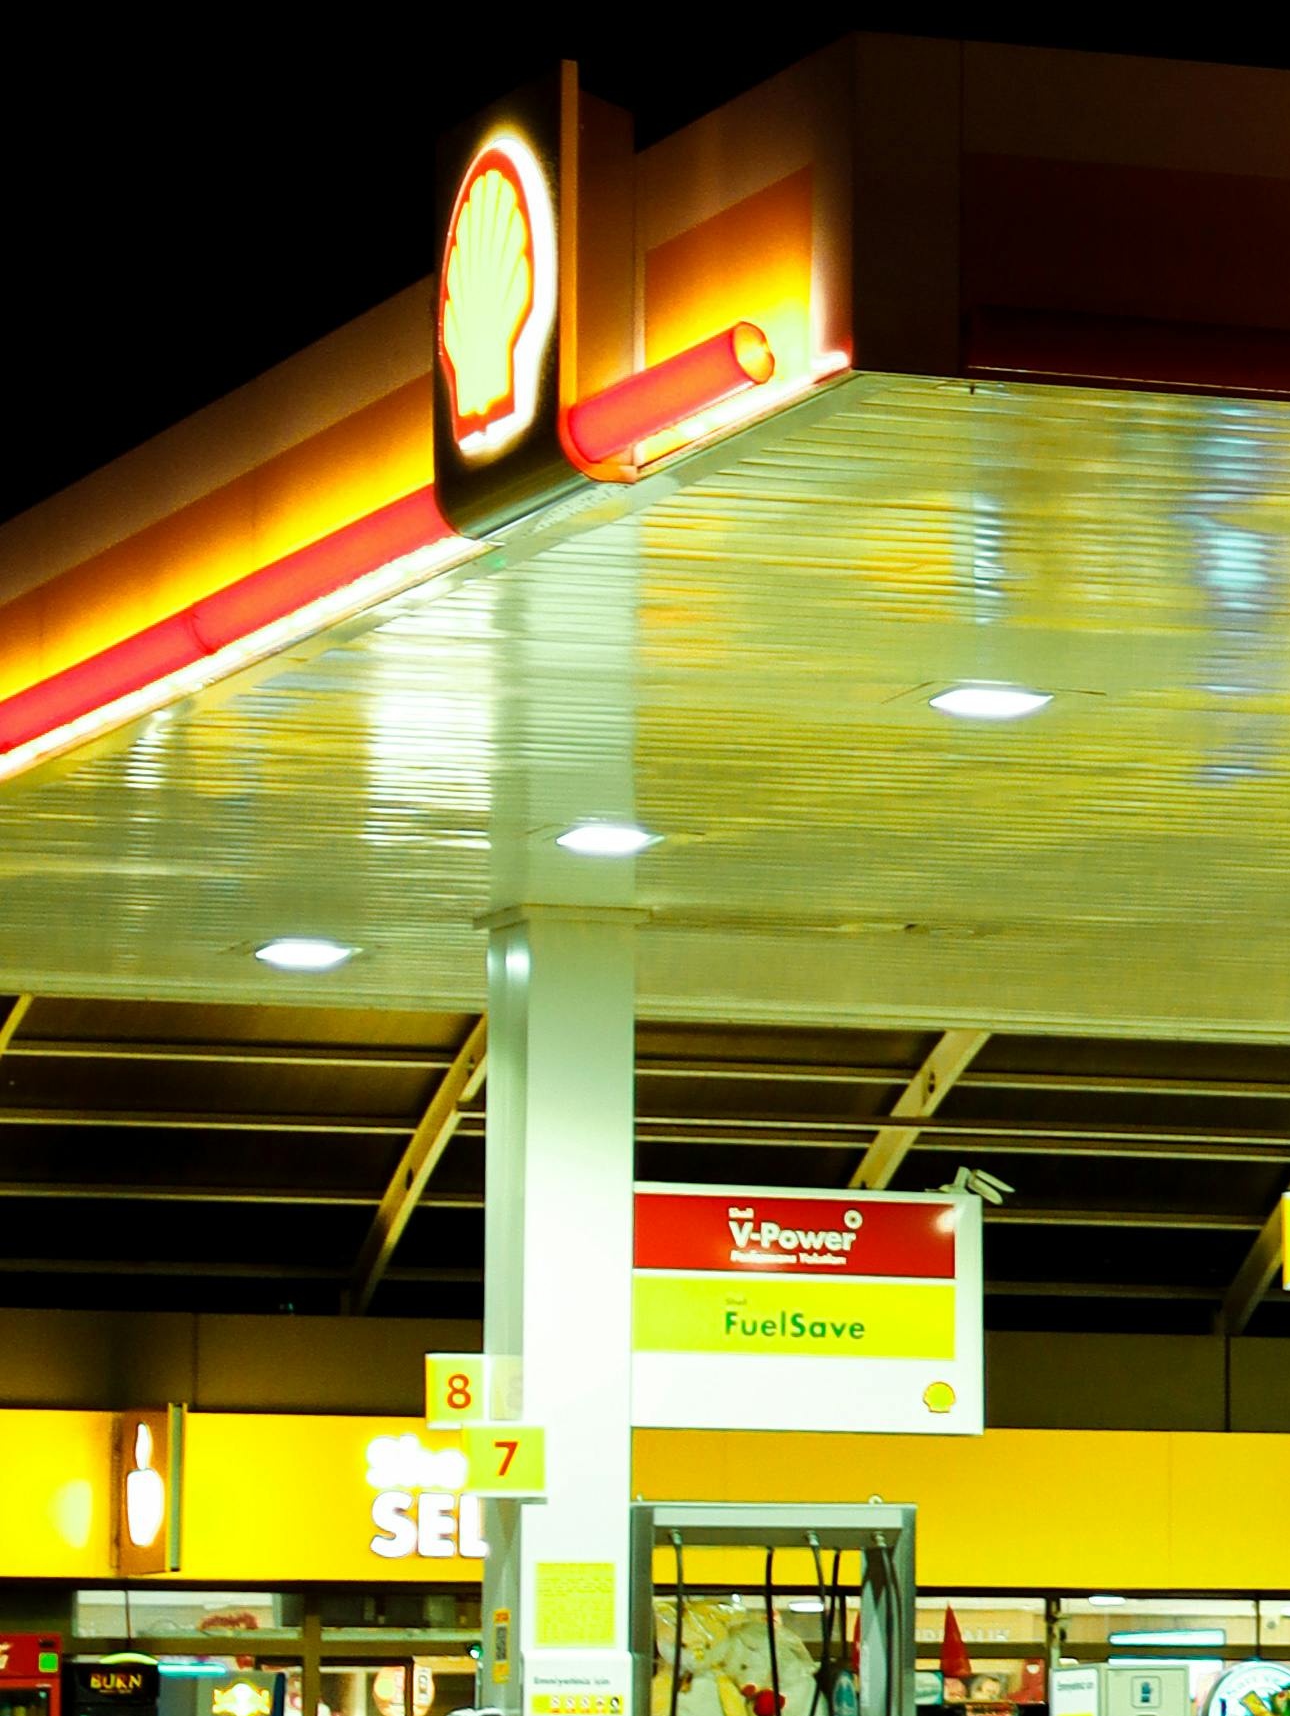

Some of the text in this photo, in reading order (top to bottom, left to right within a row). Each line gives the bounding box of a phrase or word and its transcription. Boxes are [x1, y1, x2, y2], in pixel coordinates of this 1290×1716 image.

[728, 1220, 857, 1251] V-Power
[725, 1311, 865, 1339] FuelSave
[447, 1373, 471, 1409] 8
[494, 1441, 519, 1476] 7
